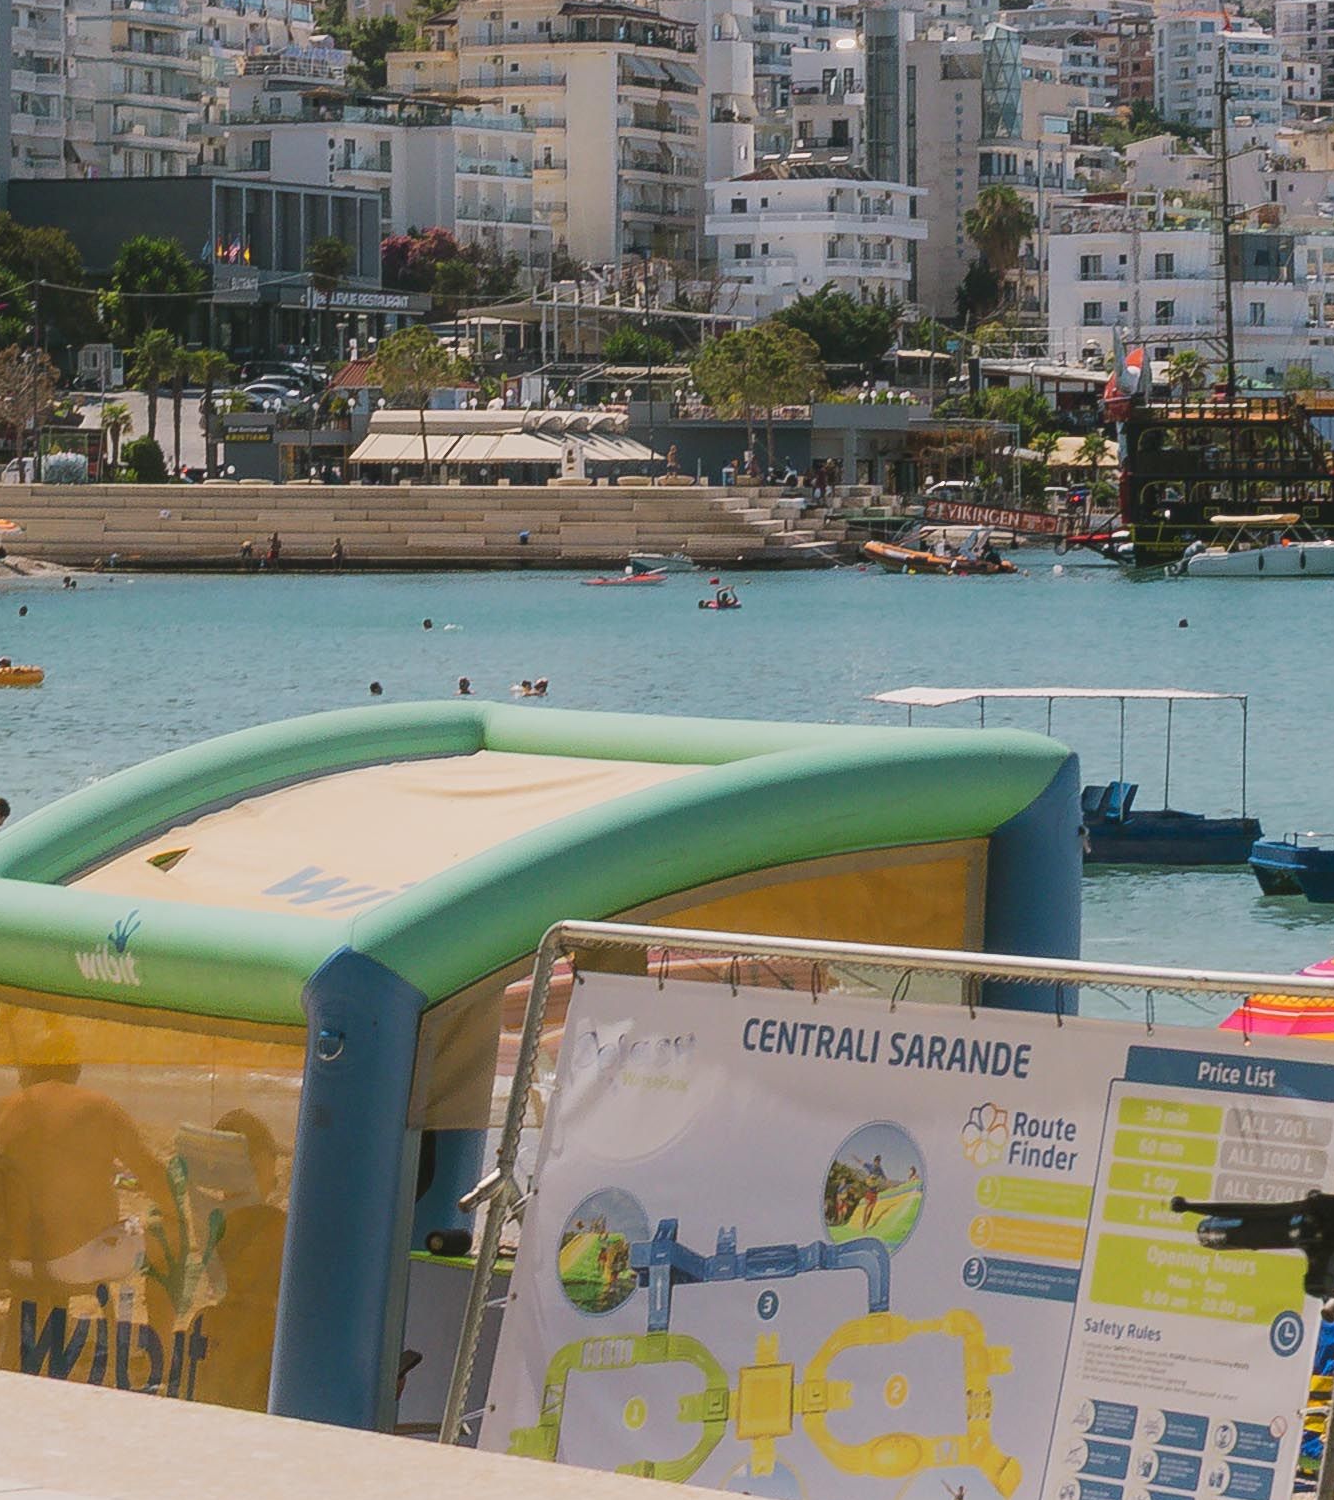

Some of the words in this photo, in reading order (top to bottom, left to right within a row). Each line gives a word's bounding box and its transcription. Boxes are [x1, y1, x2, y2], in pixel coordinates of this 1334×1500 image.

[948, 505, 1019, 526] VIKINGEN
[75, 943, 140, 987] wibit
[743, 1017, 880, 1064] CENTRALI
[887, 1031, 1032, 1079] SARANDE
[1197, 1061, 1240, 1085] Price
[1244, 1065, 1276, 1088] List
[1013, 1112, 1076, 1142] Route
[1241, 1116, 1271, 1134] ALL
[1275, 1119, 1304, 1138] 700
[1306, 1122, 1316, 1138] L
[1009, 1141, 1079, 1171] Finder
[1227, 1148, 1256, 1167] ALL
[1260, 1150, 1301, 1172] 1000
[1304, 1155, 1314, 1173] L
[1155, 1173, 1179, 1193] day
[1223, 1180, 1252, 1199] ALL
[969, 1261, 979, 1275] 3
[1147, 1245, 1209, 1274] Opening
[1213, 1253, 1256, 1276] hours
[762, 1296, 773, 1313] 3
[1084, 1317, 1123, 1340] Safety
[1127, 1323, 1161, 1342] Rules
[20, 1283, 208, 1402] wibit
[891, 1382, 902, 1398] 2
[631, 1404, 641, 1421] 1
